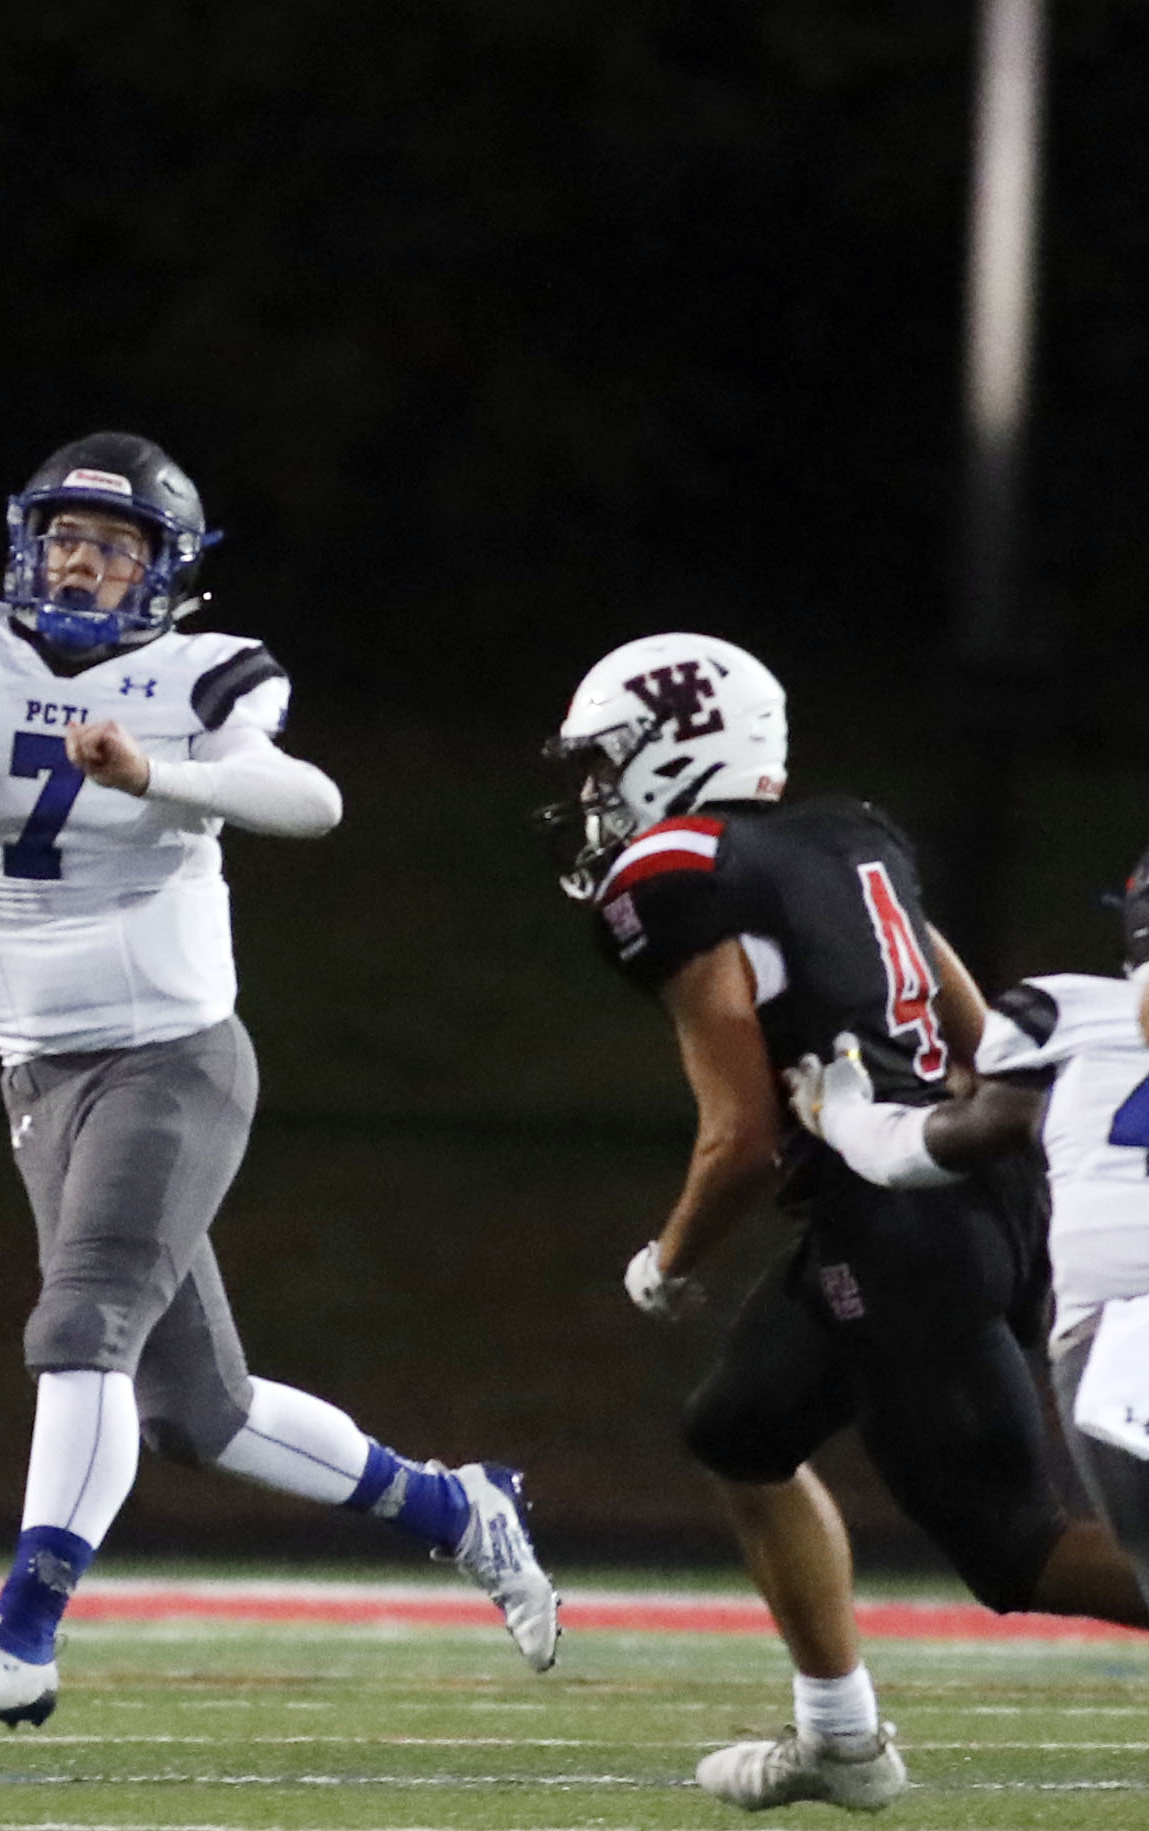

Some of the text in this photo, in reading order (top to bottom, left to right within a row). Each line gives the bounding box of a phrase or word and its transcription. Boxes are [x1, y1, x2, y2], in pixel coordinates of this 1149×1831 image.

[623, 661, 725, 743] WE
[2, 731, 87, 880] 7
[857, 861, 948, 1081] 4
